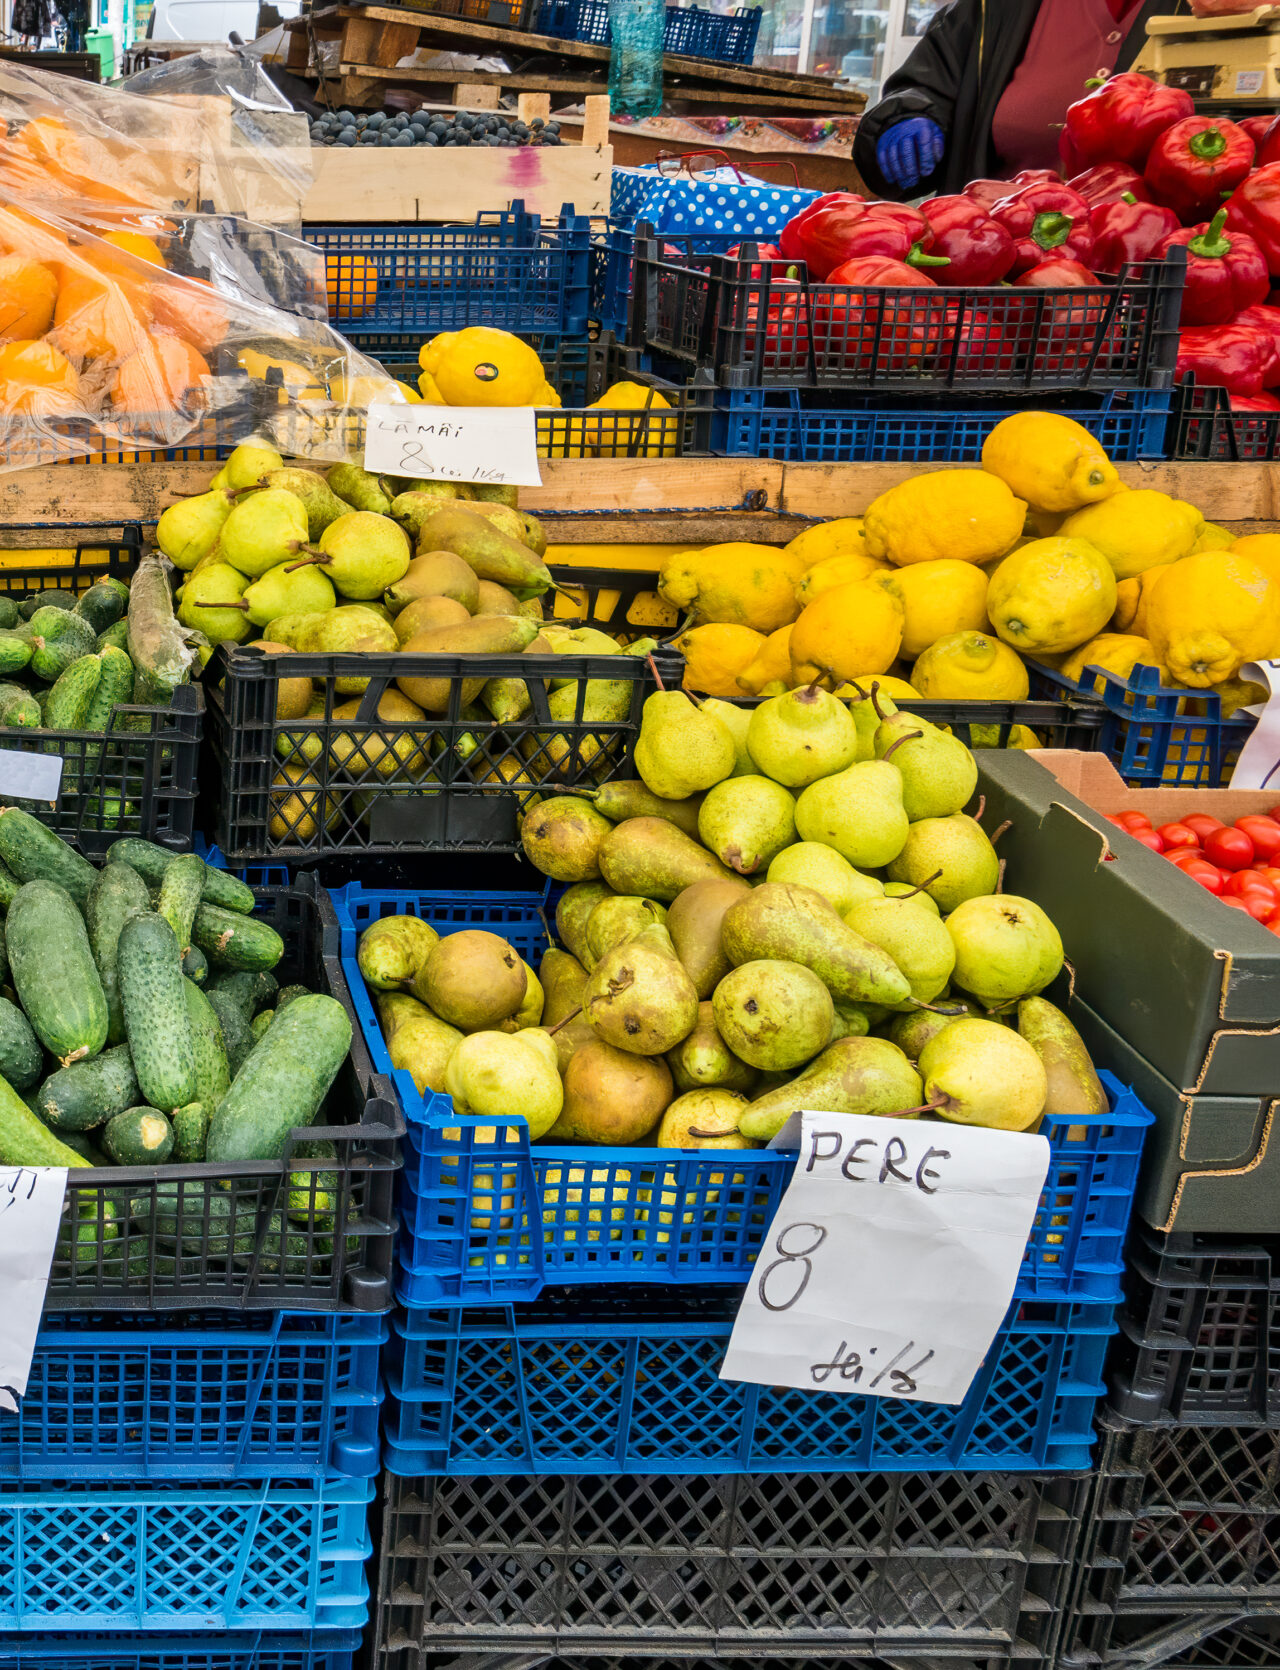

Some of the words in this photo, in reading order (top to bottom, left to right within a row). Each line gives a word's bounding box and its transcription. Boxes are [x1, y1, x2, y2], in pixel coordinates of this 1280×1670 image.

[399, 441, 435, 474] 8
[806, 1130, 951, 1194] PERE
[758, 1222, 827, 1311] 8
